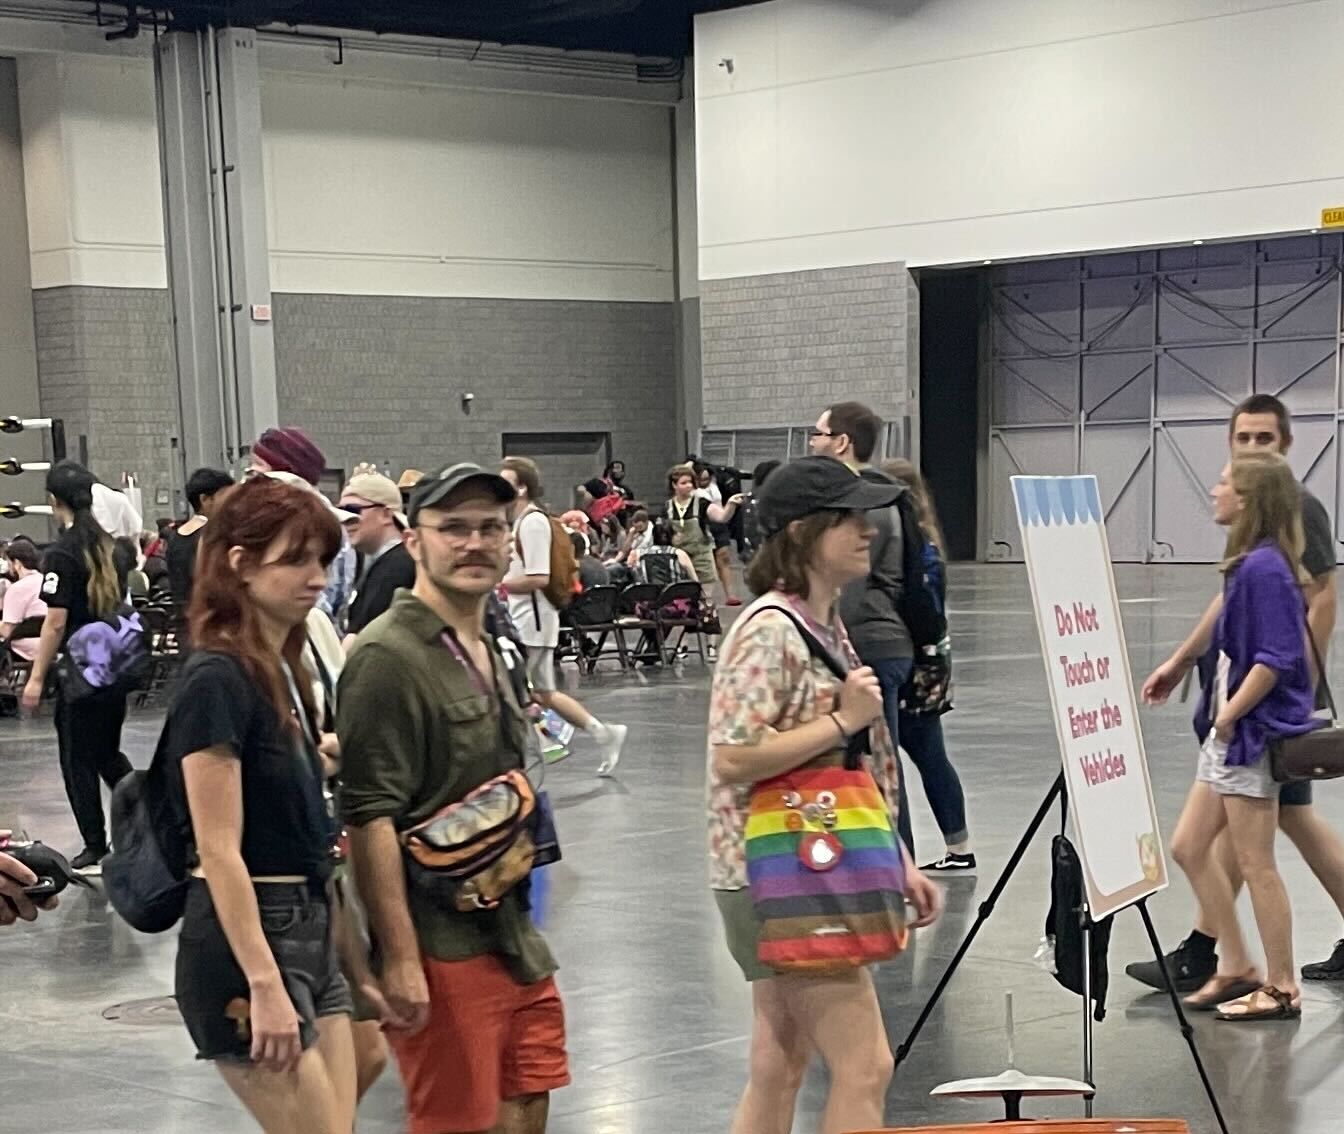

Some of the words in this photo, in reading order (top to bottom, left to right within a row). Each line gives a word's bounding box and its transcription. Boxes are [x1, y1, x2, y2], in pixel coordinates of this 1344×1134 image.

[1054, 604, 1073, 637] Do
[1072, 602, 1100, 634] Not
[1059, 651, 1096, 688] Touch
[1096, 656, 1110, 680] or
[1067, 705, 1099, 740] Enter
[1100, 697, 1122, 730] the
[1079, 748, 1127, 788] Vehicles
